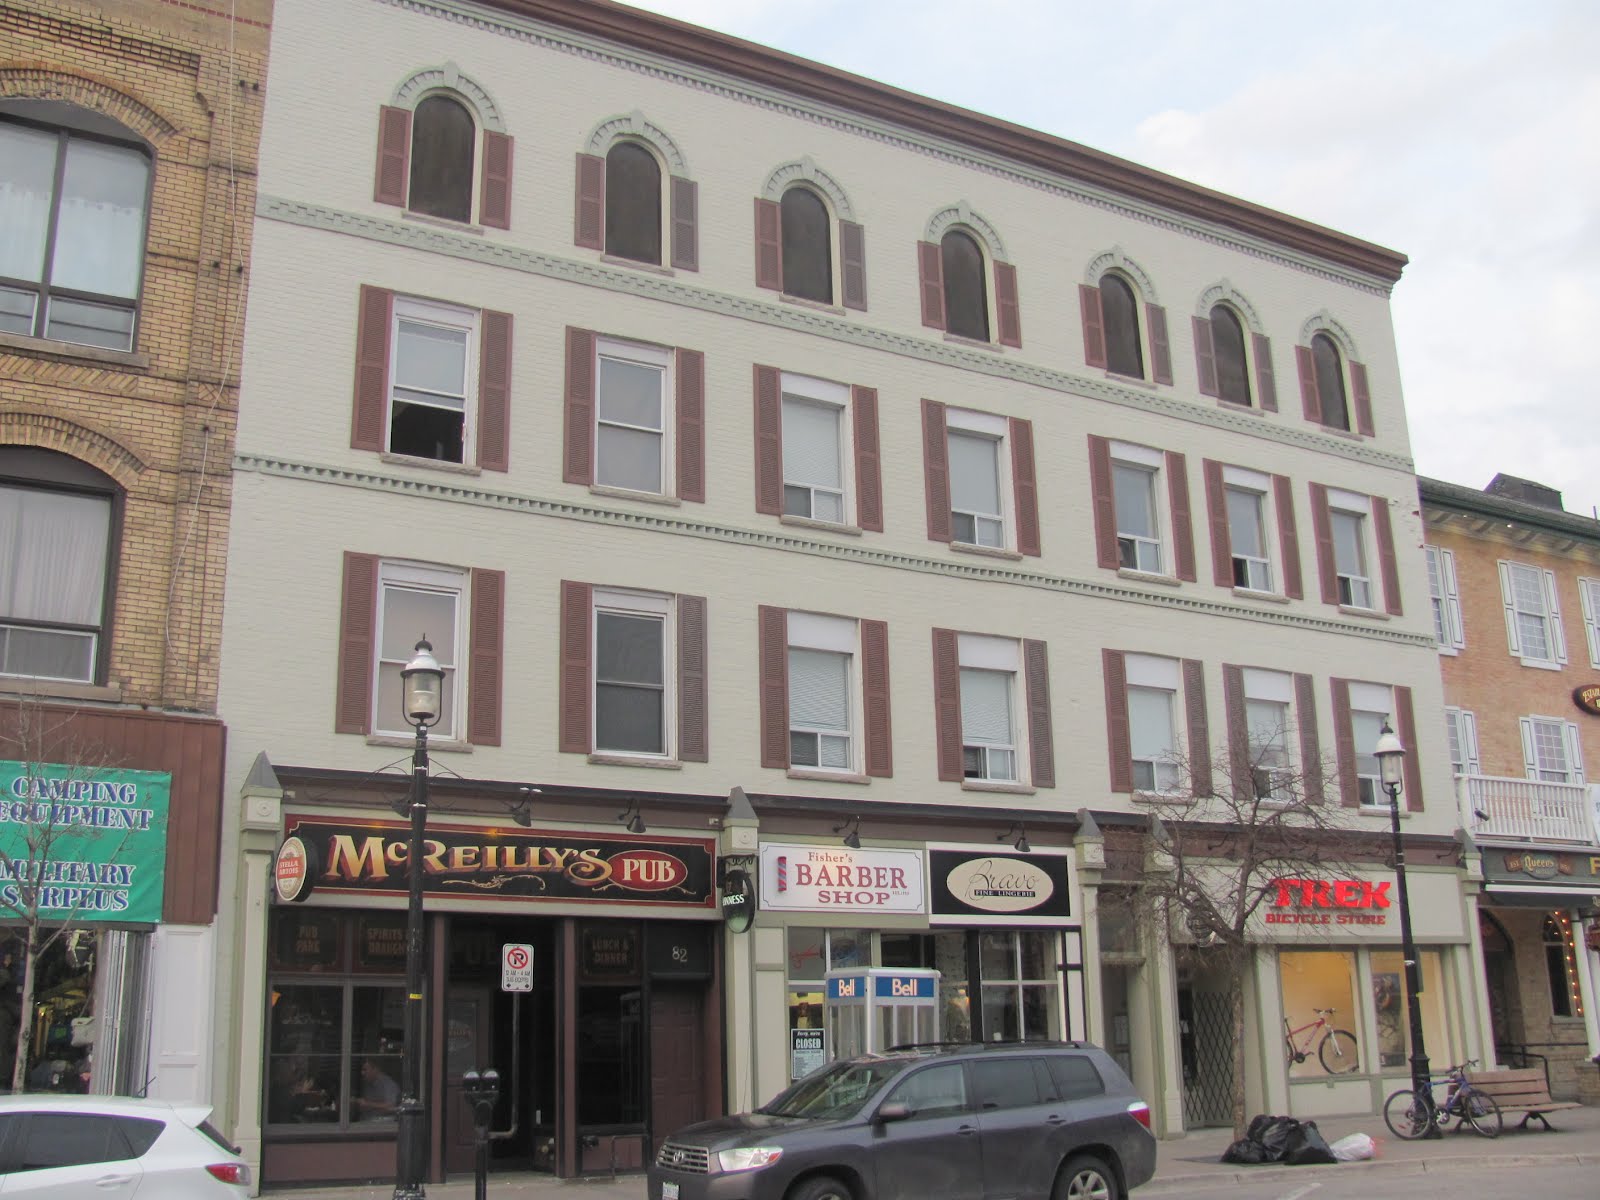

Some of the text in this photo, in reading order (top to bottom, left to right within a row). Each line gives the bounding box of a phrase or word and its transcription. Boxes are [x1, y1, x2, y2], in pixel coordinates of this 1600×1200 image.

[12, 776, 137, 804] CAMPING
[0, 801, 153, 830] EQUIPMENT
[808, 851, 853, 863] Fisher's
[0, 859, 136, 886] MILITARY
[622, 858, 676, 882] PUB
[795, 863, 907, 889] BARBER
[3, 885, 129, 911] SURPLUS
[818, 890, 890, 905] SHOP
[1273, 878, 1391, 908] TREK
[1265, 913, 1386, 925] BICYCLE STORE
[672, 945, 688, 962] 82
[838, 979, 855, 997] Bell
[892, 978, 917, 996] Bell
[795, 1038, 822, 1049] CLOSED
